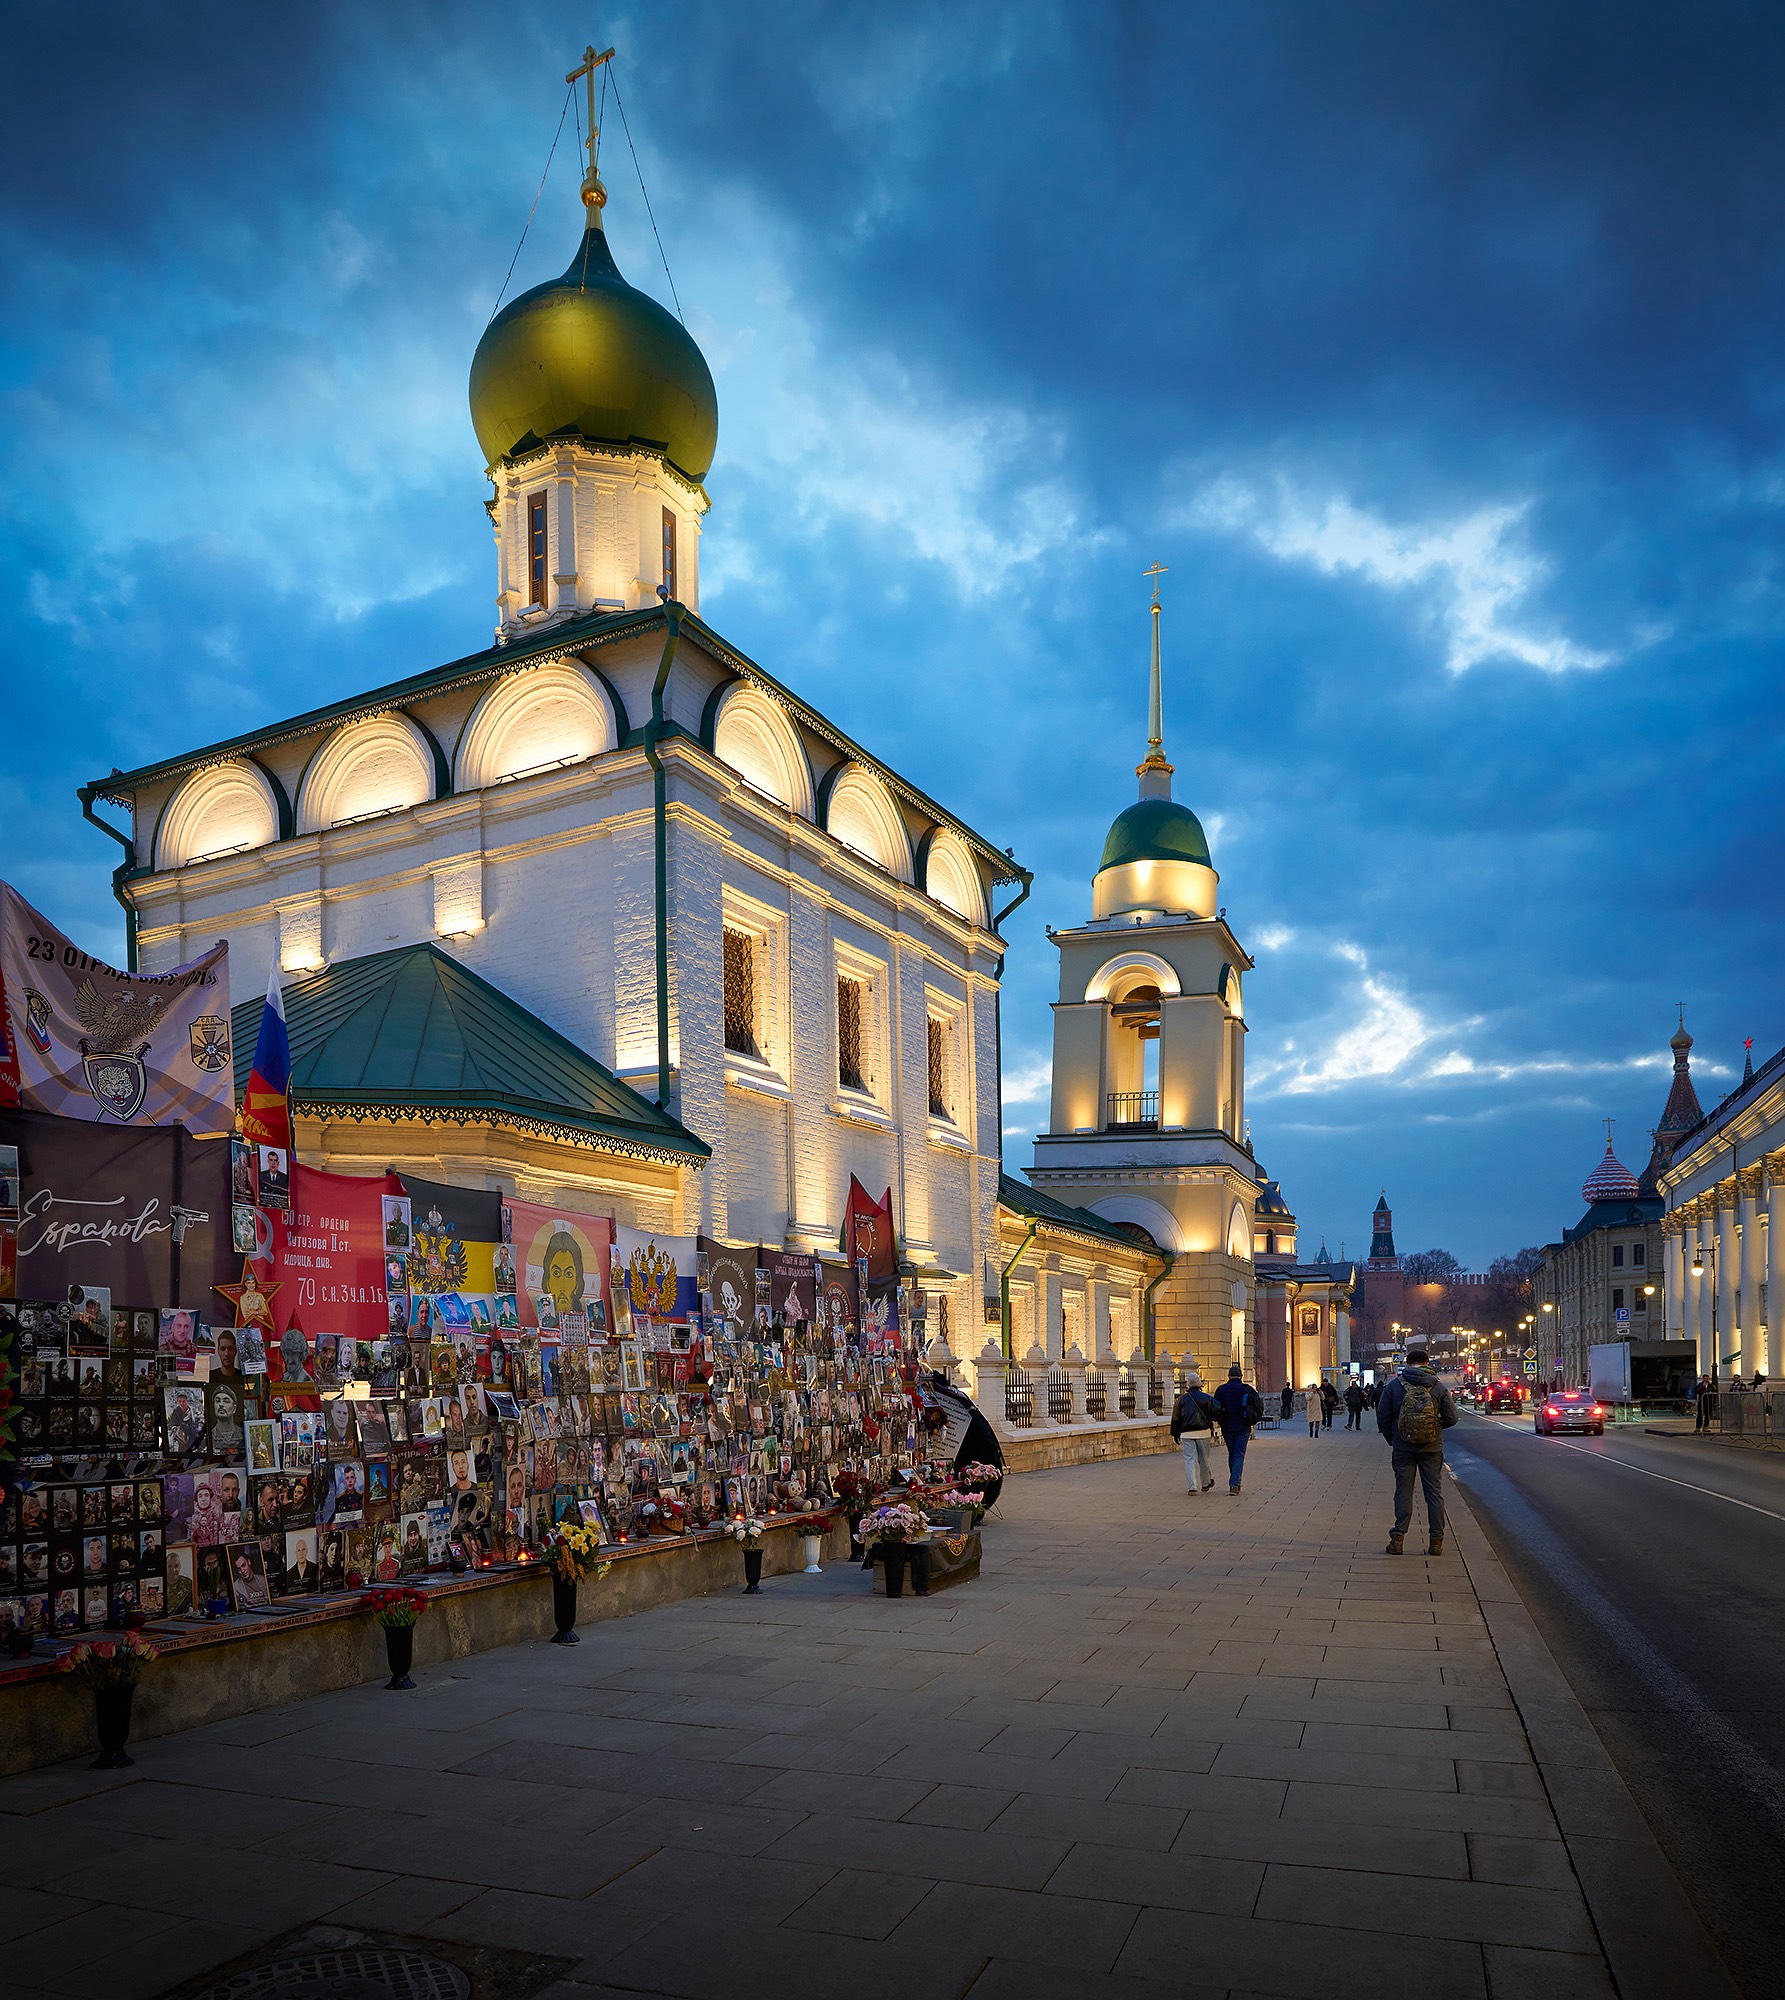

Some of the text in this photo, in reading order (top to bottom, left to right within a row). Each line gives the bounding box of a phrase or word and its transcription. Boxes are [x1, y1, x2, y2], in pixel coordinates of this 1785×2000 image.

[27, 936, 55, 962] 23
[320, 1217, 349, 1231] ОРДЕНА
[297, 1277, 316, 1306] 79
